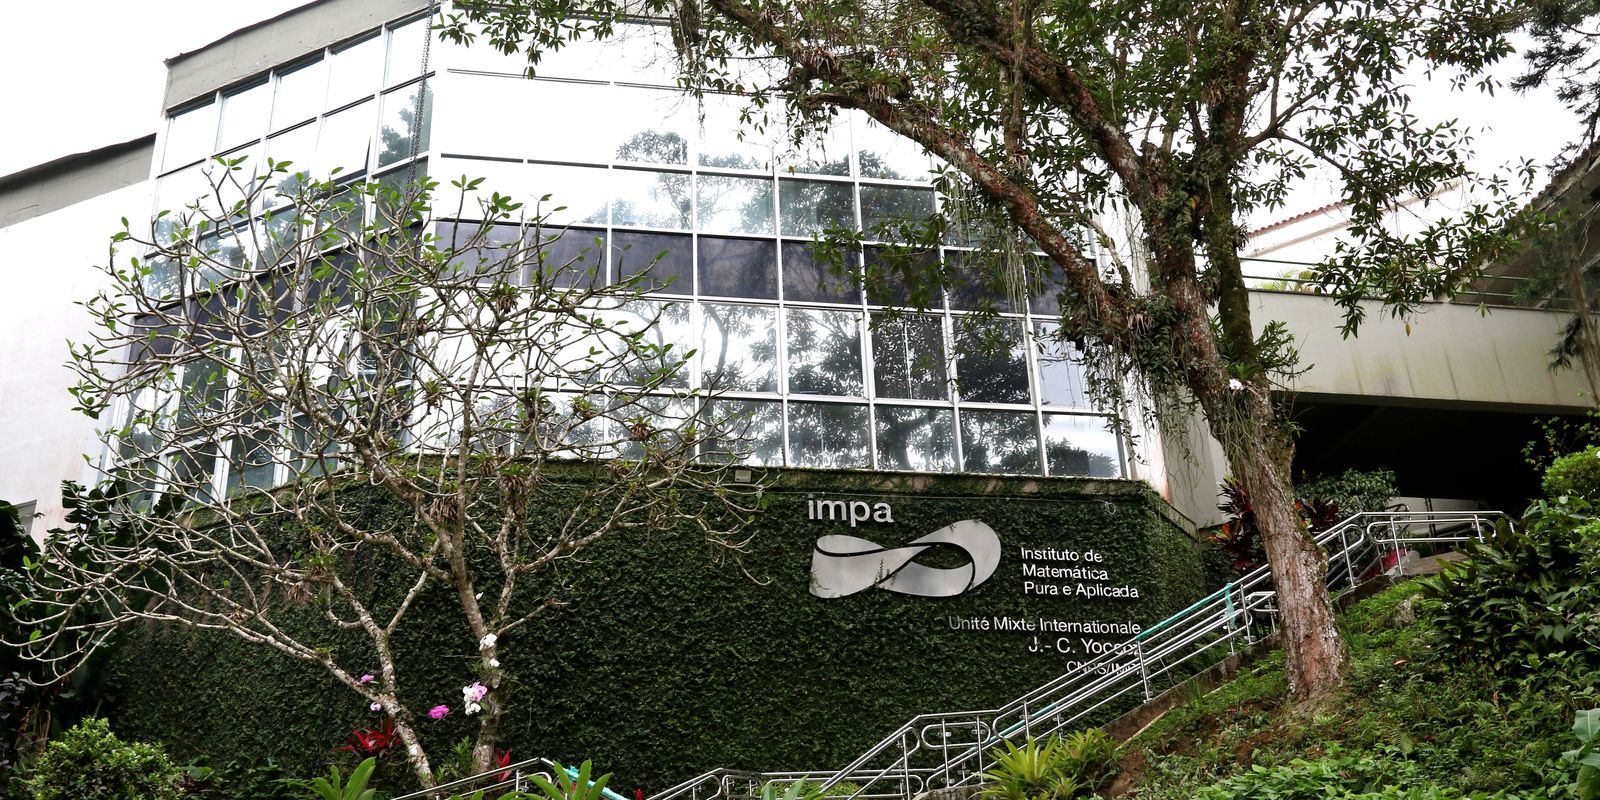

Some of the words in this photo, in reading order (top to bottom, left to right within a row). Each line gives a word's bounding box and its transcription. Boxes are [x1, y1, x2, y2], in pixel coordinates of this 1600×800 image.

[808, 493, 894, 527] impa
[1021, 547, 1079, 561] Instituto
[1084, 549, 1103, 562] de
[1022, 563, 1109, 580] Matemática
[1024, 581, 1058, 595] Pura
[1062, 585, 1072, 595] e
[1075, 583, 1139, 599] Aplicada
[948, 615, 990, 631] Unité
[993, 616, 1036, 631] Mixte
[1040, 618, 1141, 635] Internationale
[1056, 637, 1076, 653] C.
